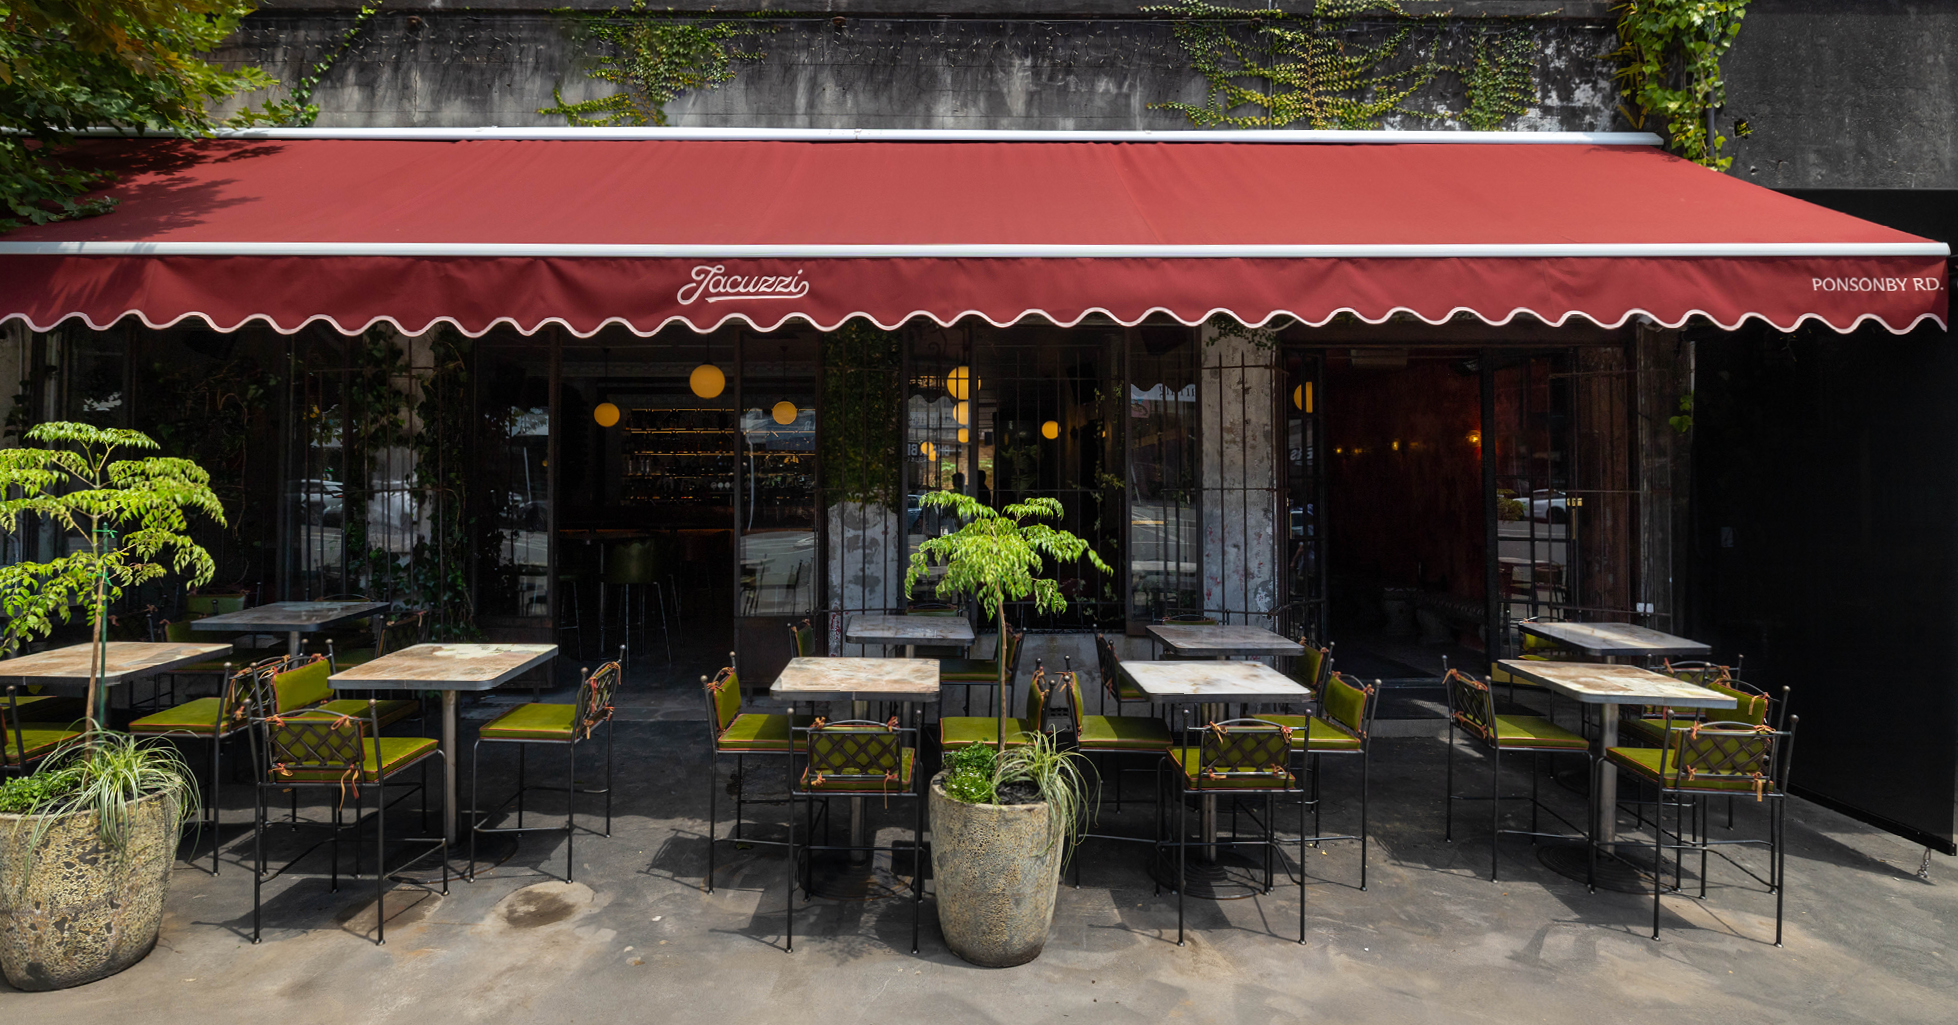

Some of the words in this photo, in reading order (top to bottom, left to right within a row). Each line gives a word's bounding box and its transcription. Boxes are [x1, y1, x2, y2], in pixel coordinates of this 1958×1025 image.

[677, 264, 810, 305] Jacuzzi
[1812, 277, 1908, 292] PONSONBY
[1912, 277, 1944, 291] RD.
